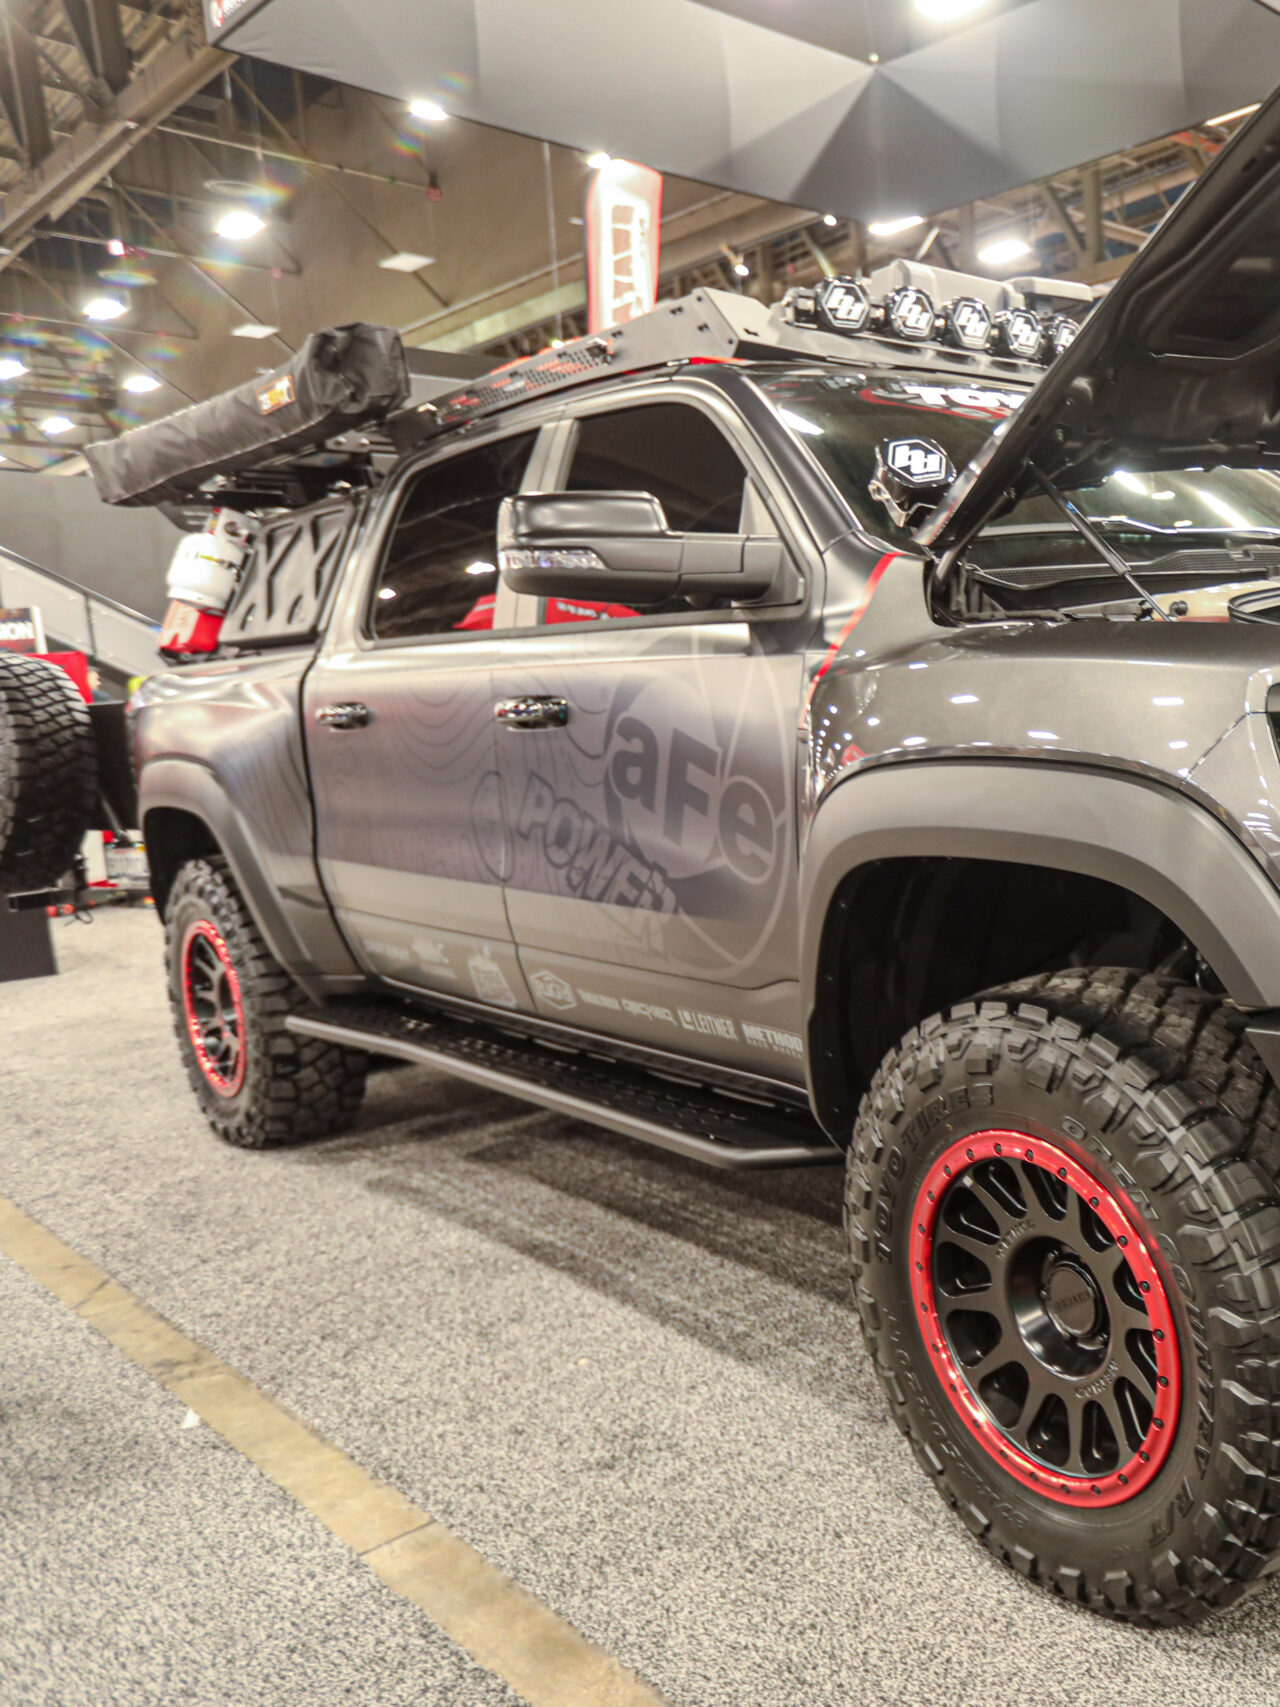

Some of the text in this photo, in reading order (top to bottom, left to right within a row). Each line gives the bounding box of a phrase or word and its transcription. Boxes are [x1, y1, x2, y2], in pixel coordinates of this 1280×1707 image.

[516, 770, 680, 958] POWER
[611, 716, 776, 880] aFe
[694, 1012, 739, 1041] LEITNER
[741, 1020, 804, 1053] METHOD
[874, 1083, 995, 1264] TOYO TIRES
[1061, 1115, 1160, 1220] OPEN
[1157, 1232, 1215, 1481] COUNTRY
